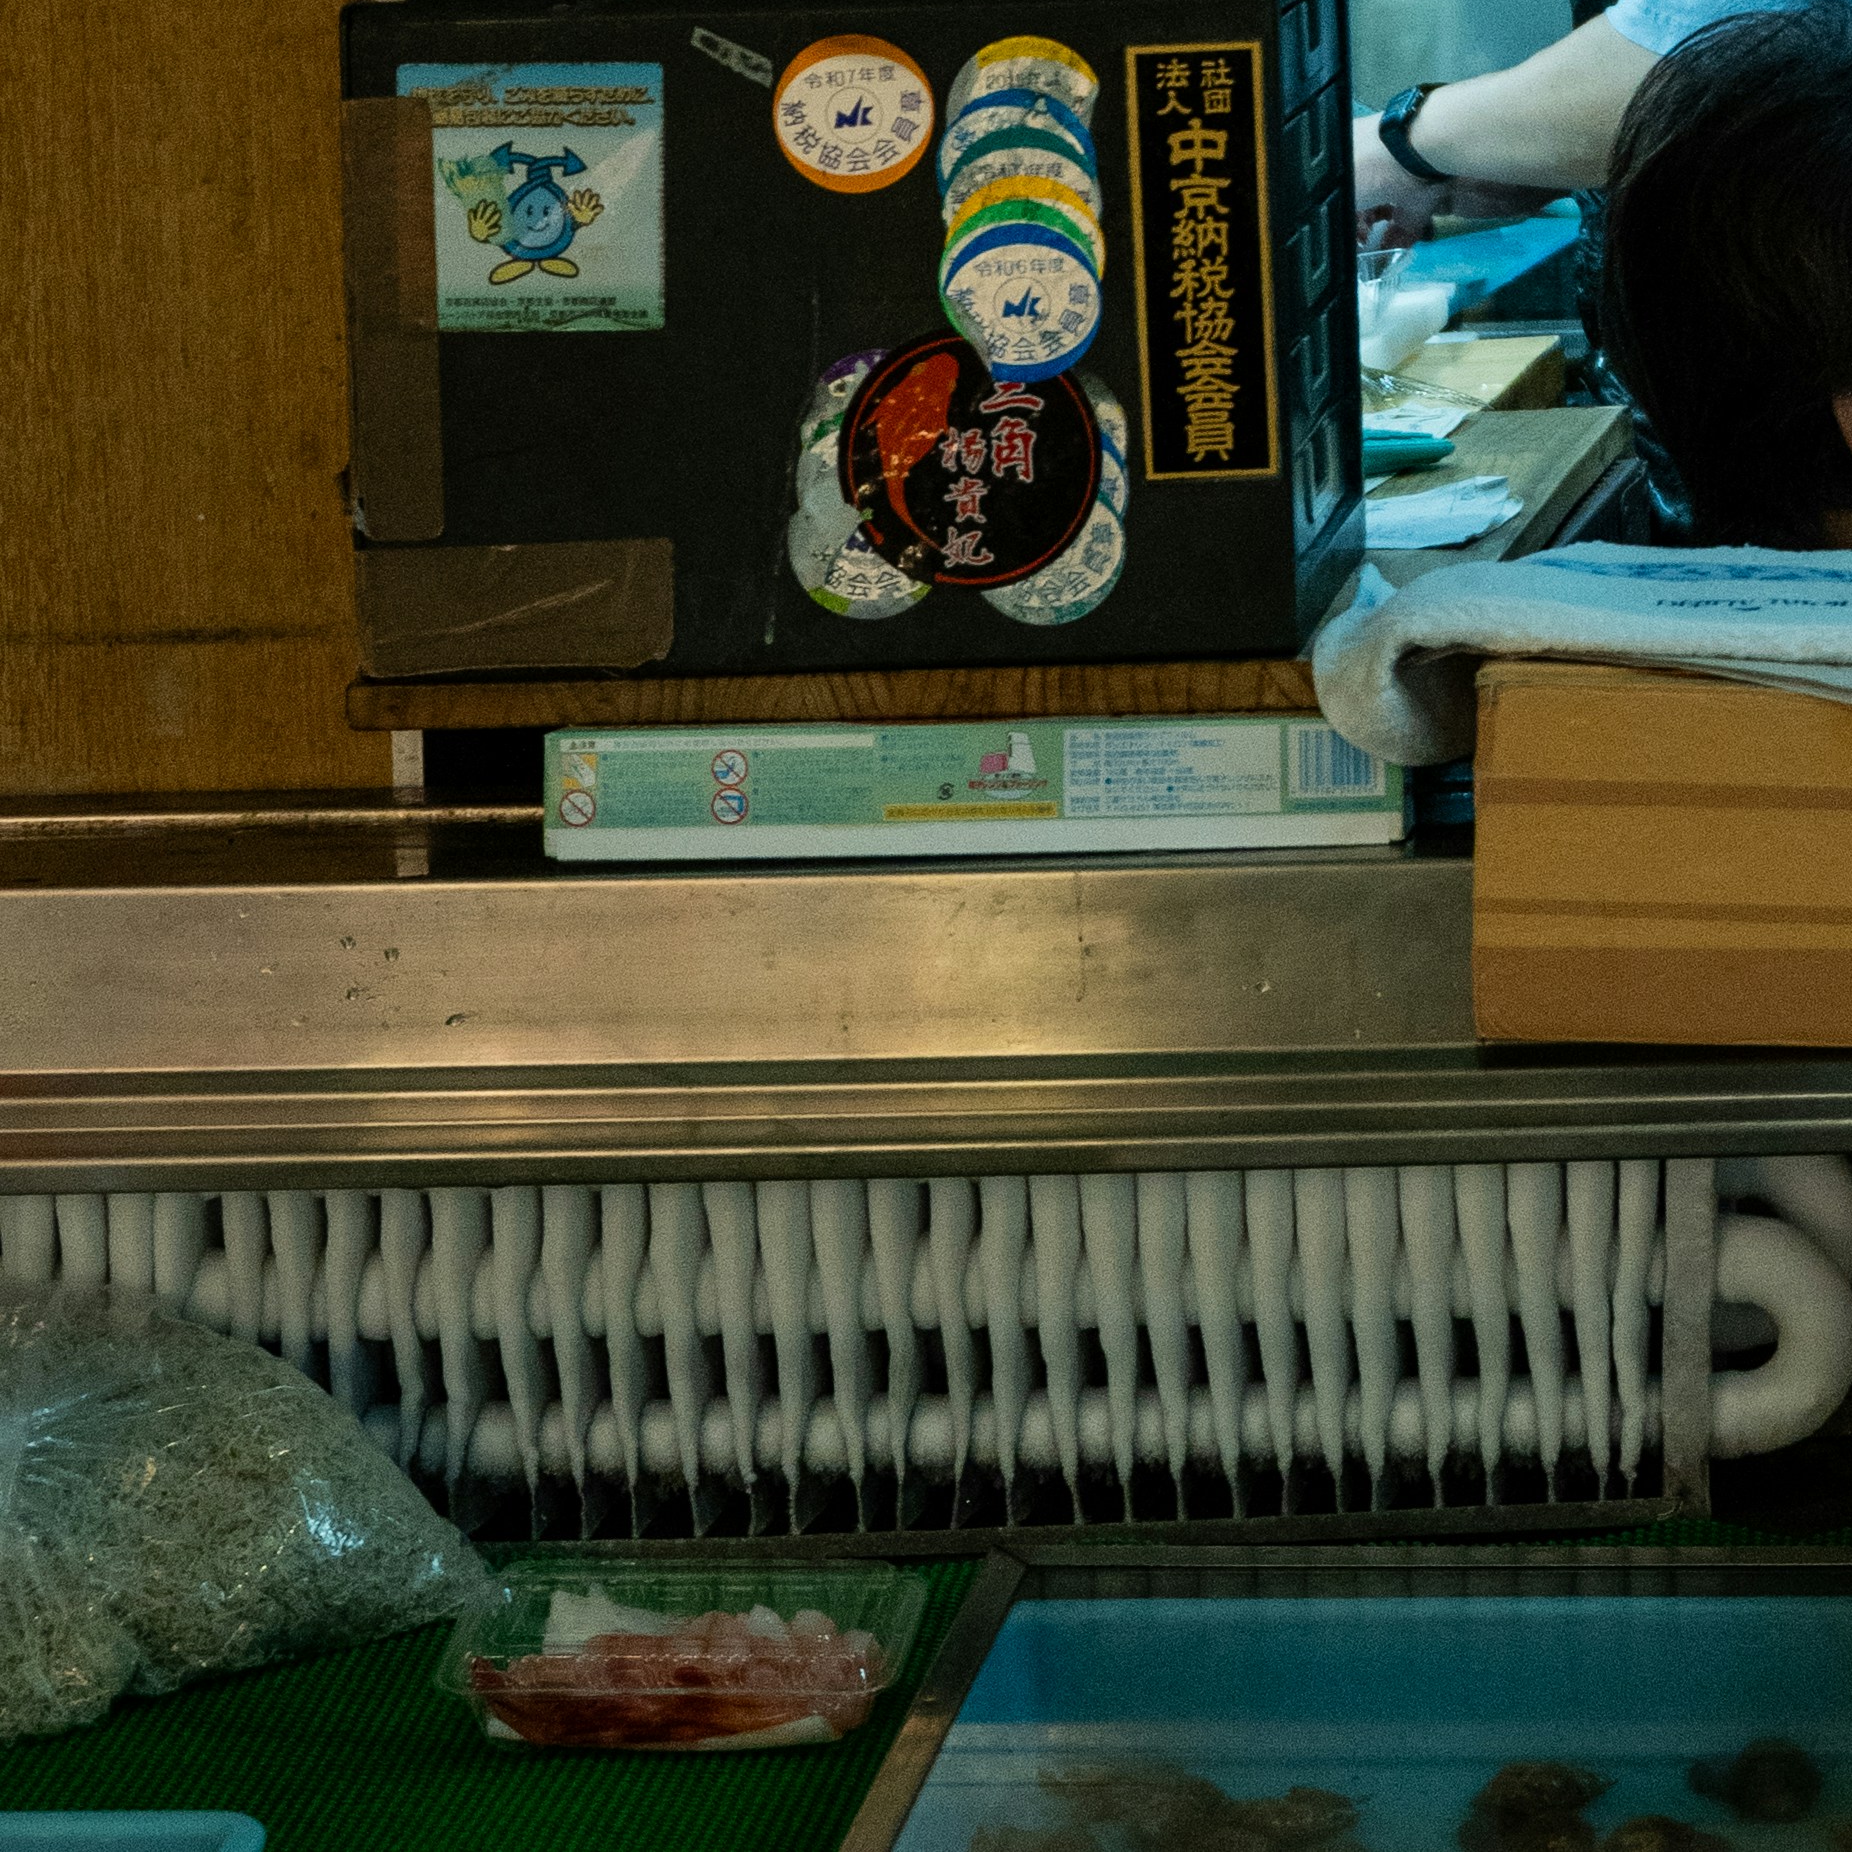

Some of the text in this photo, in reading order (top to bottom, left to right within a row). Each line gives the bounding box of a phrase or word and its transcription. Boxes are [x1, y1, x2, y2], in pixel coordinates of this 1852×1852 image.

[804, 64, 897, 90] 令和7年度
[1166, 117, 1242, 464] 中京納税協会会員
[938, 426, 995, 568] 楊貴妃
